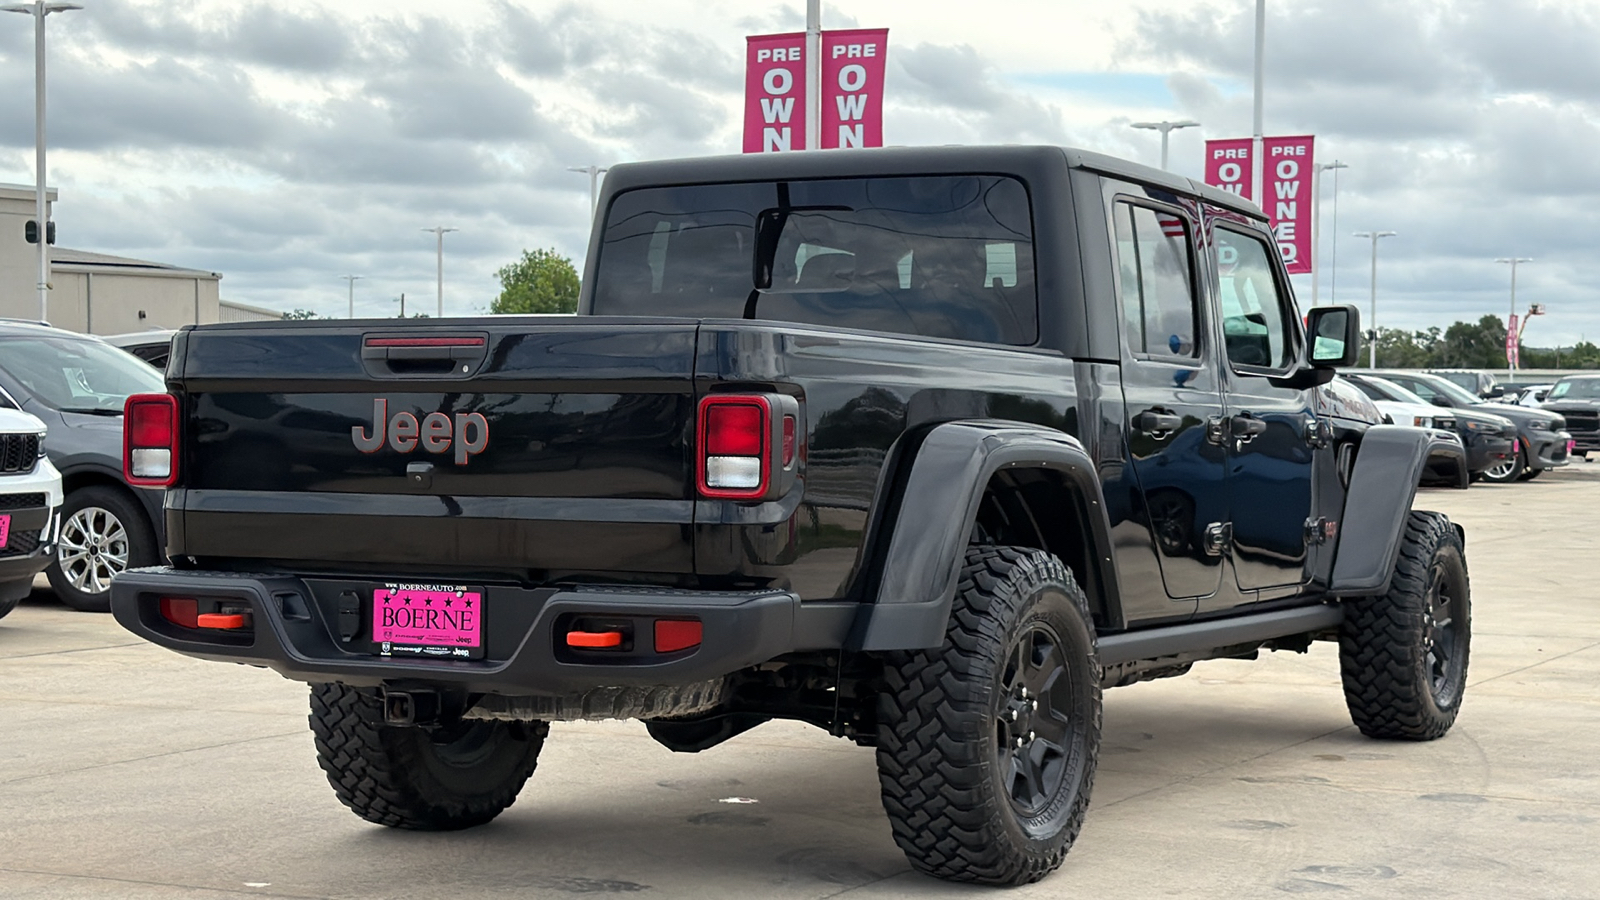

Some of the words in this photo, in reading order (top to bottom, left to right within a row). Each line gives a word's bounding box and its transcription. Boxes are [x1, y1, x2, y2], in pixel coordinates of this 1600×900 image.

[757, 47, 801, 63] PRE
[832, 44, 876, 59] PRE
[1213, 148, 1248, 160] PRE
[1271, 146, 1306, 157] PRE
[1274, 160, 1300, 261] OWNED
[351, 398, 489, 465] Jeep
[382, 606, 474, 631] BOERNE
